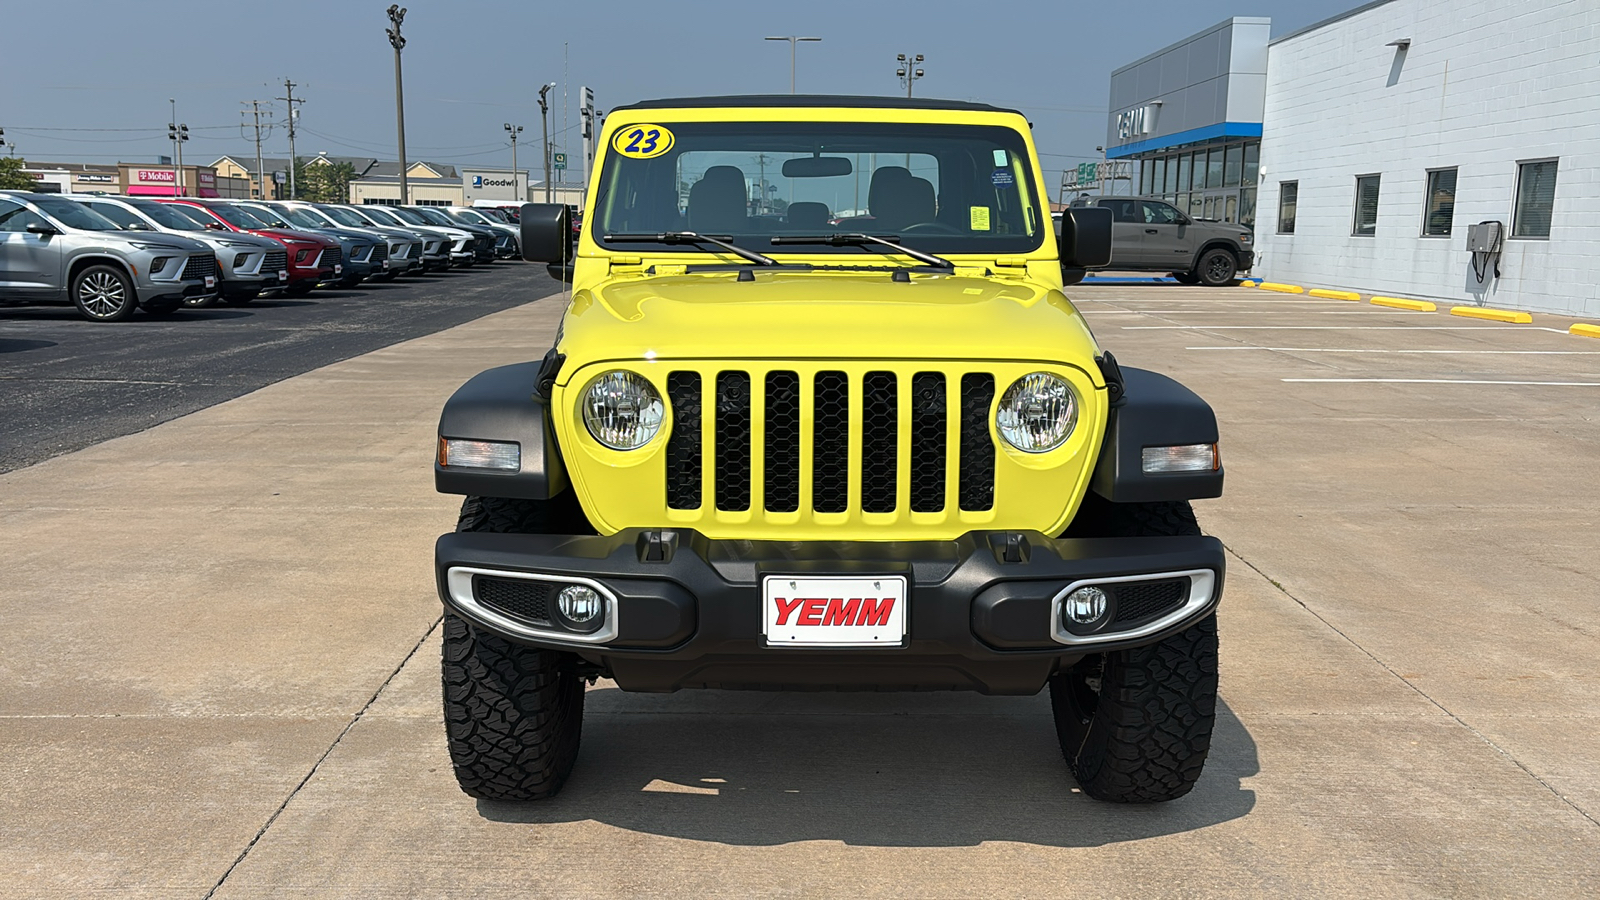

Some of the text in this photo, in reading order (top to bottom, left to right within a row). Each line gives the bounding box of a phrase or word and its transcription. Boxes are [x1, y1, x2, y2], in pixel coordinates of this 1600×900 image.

[625, 129, 660, 153] 23
[483, 178, 518, 187] Goodwil
[774, 597, 896, 626] YEMM
